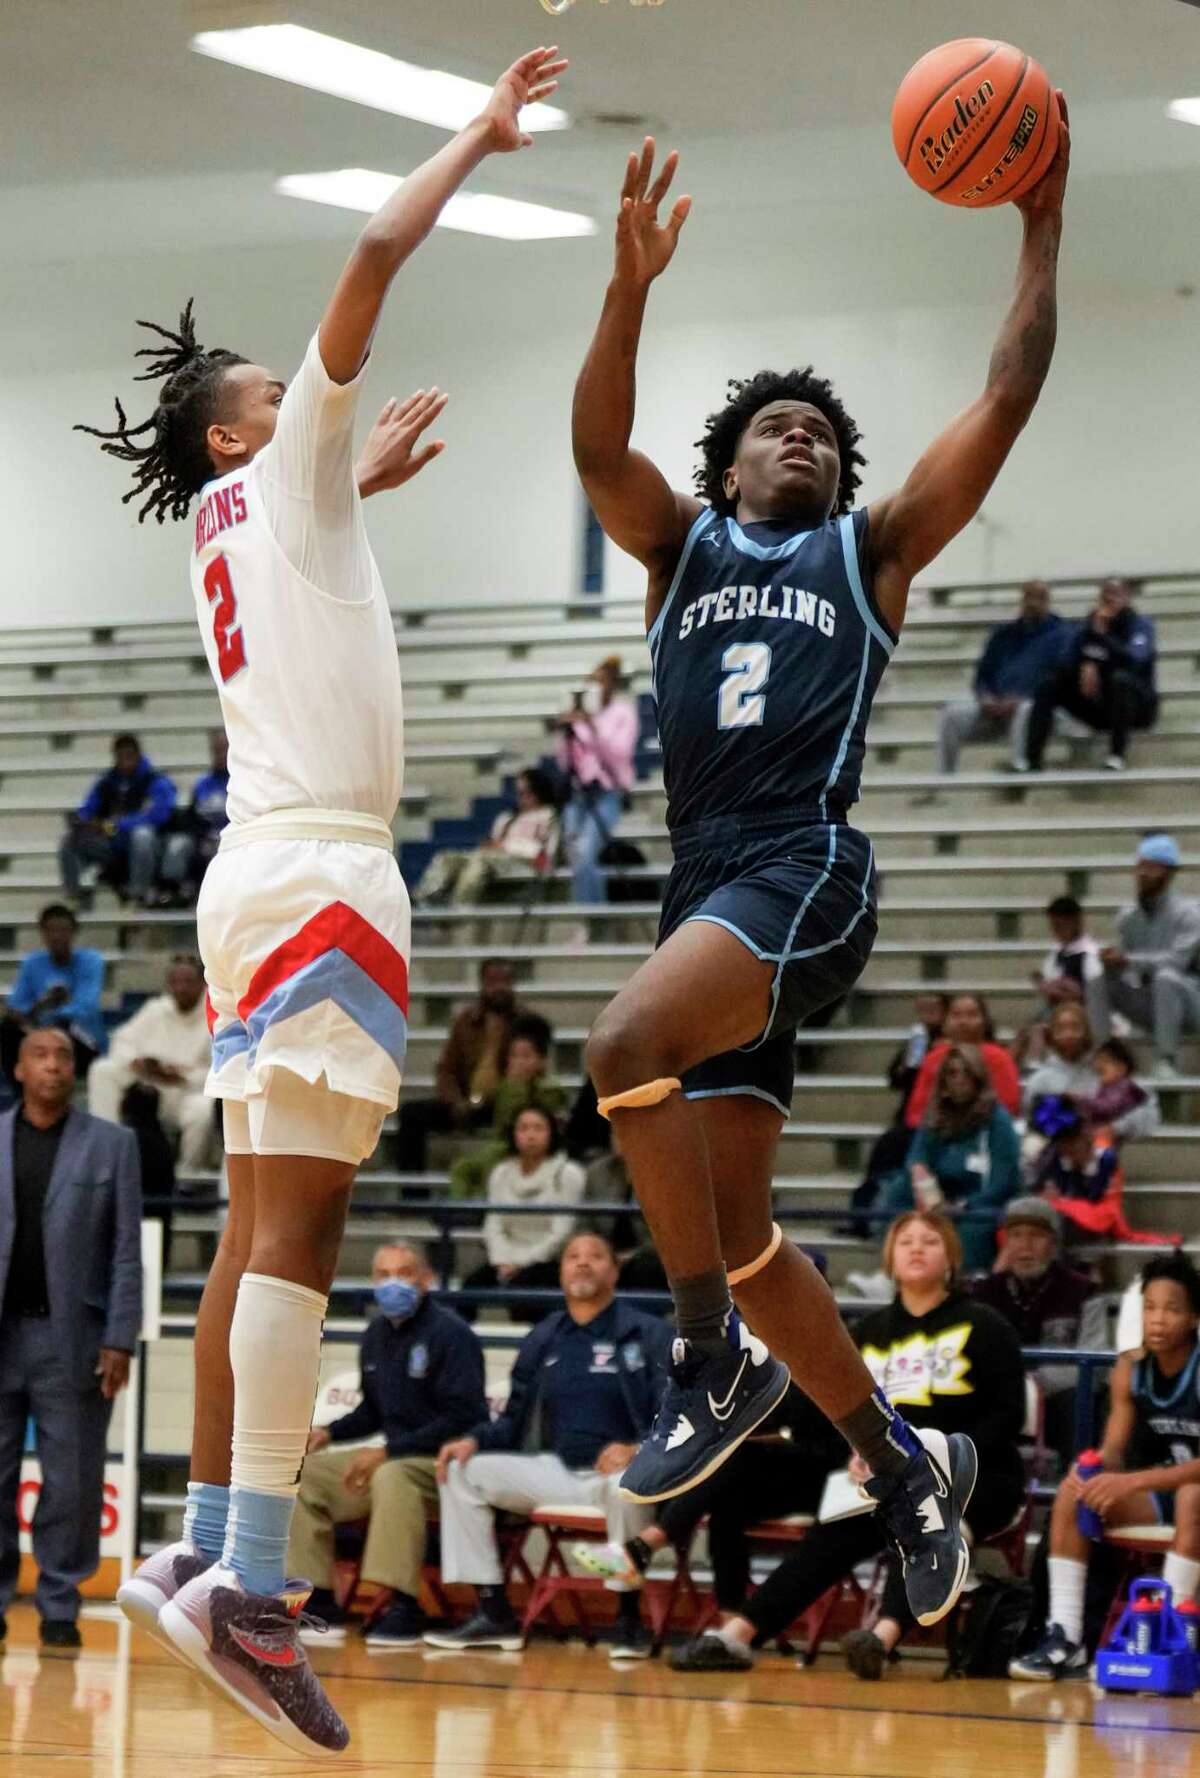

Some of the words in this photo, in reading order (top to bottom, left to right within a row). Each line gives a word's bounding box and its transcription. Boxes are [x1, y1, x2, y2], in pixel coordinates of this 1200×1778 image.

[919, 79, 995, 176] Baden
[203, 552, 249, 684] 2
[678, 584, 836, 640] STERLING
[717, 641, 773, 731] 2
